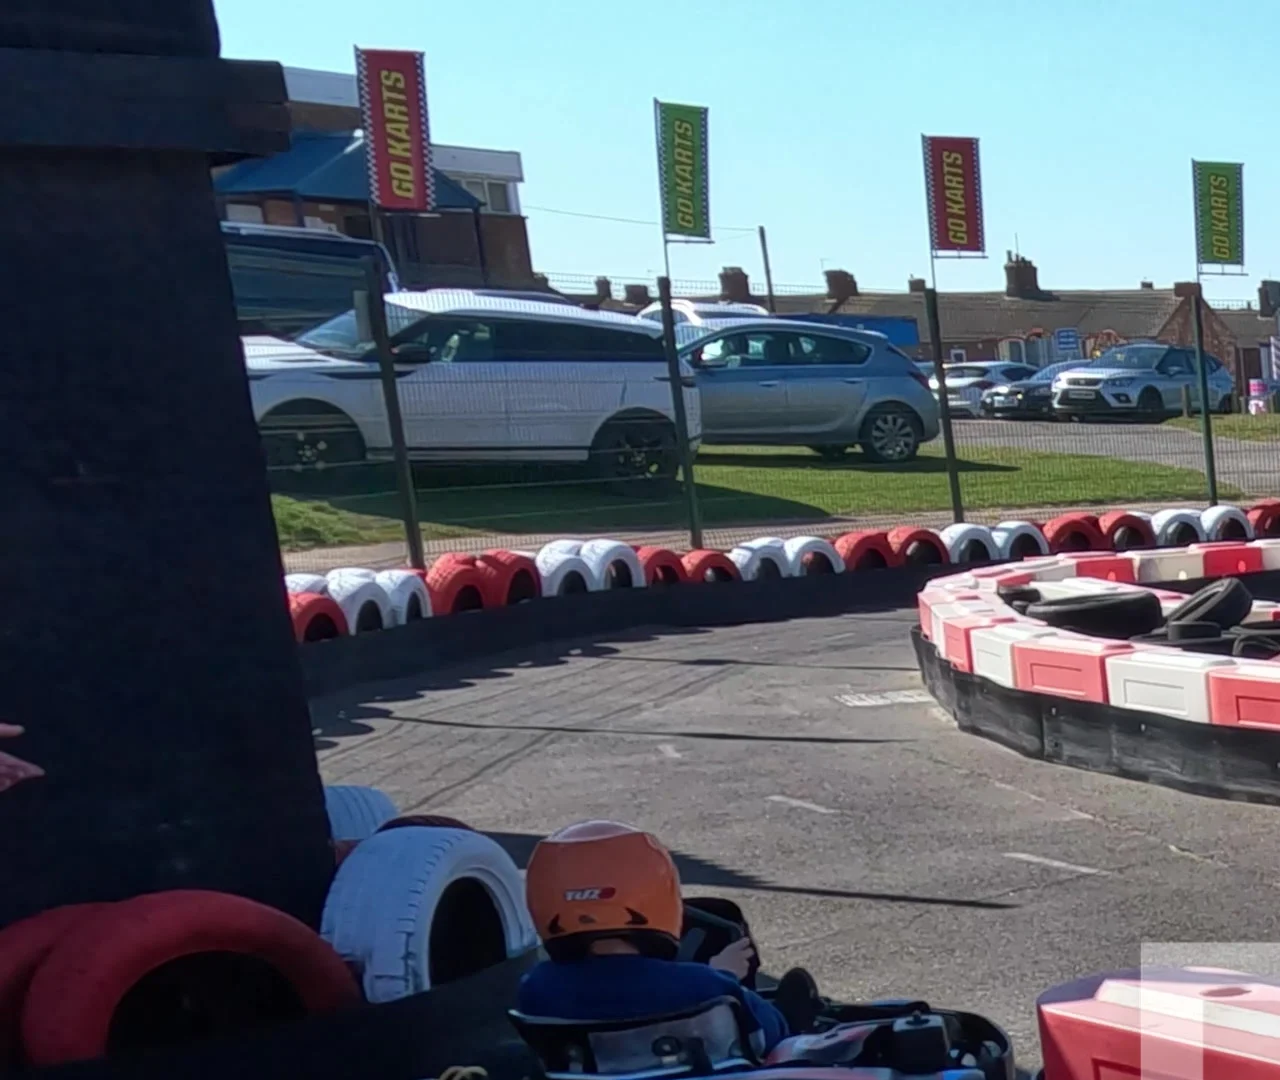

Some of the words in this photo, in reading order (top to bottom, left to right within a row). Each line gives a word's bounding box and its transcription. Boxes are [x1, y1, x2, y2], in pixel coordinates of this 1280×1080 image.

[381, 70, 412, 157] KARTS
[390, 162, 415, 199] GO
[674, 121, 693, 194] KARTS
[942, 151, 966, 215] KARTS
[1210, 174, 1229, 233] KARTS
[677, 199, 694, 228] GO
[947, 219, 968, 244] GO
[1212, 235, 1230, 258] GO
